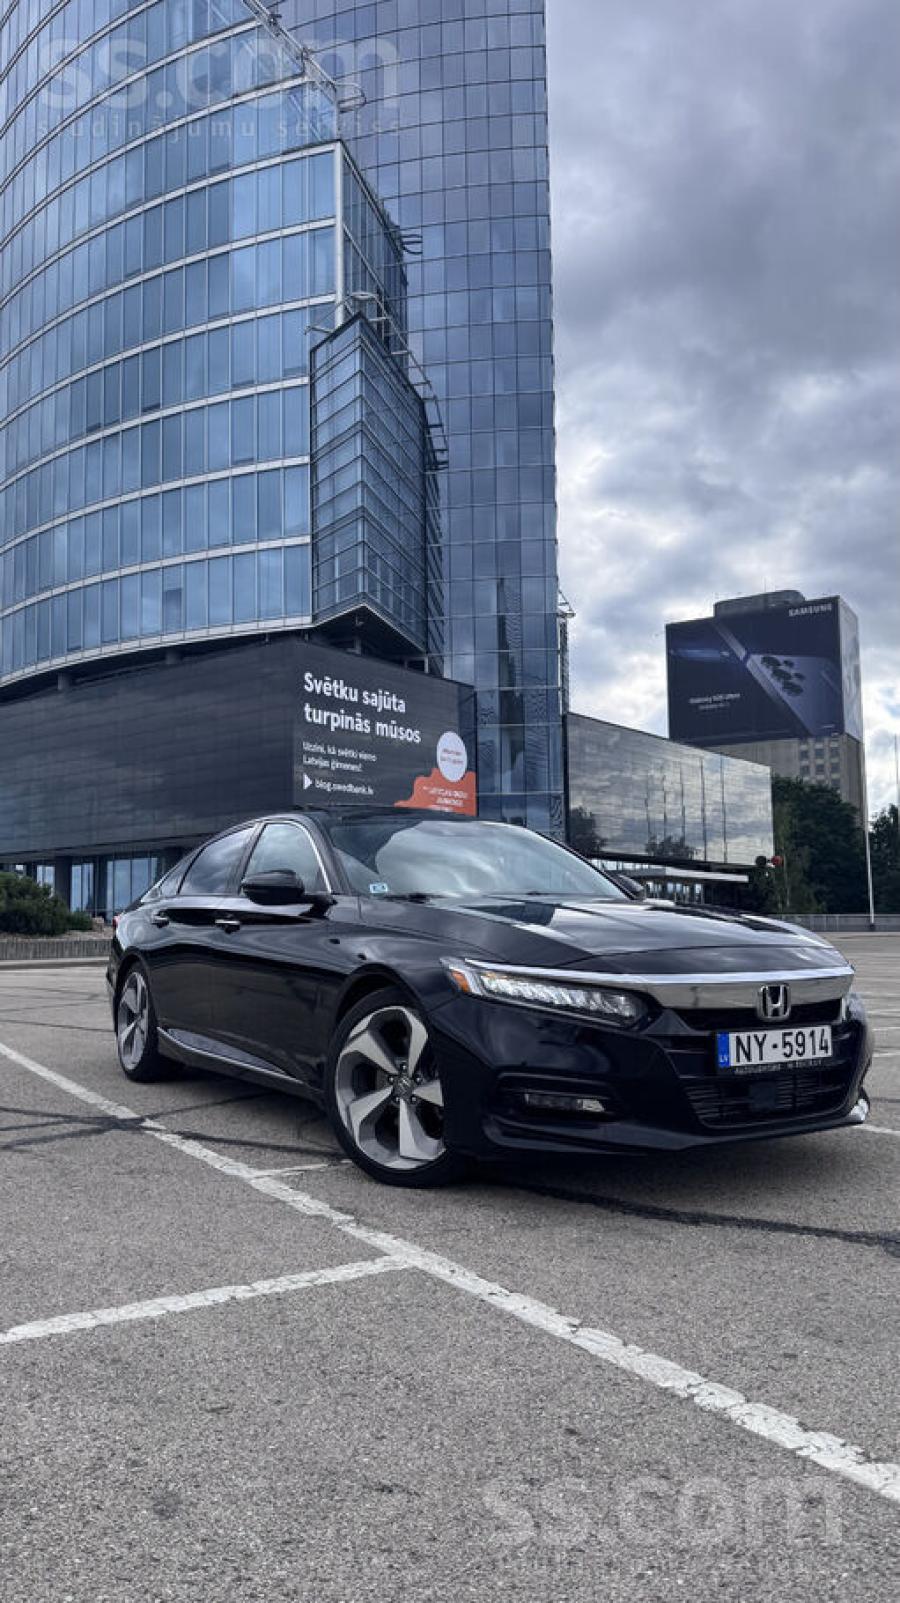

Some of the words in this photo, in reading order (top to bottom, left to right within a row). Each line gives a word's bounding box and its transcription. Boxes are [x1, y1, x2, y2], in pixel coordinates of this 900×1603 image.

[303, 671, 359, 702] Svētku
[362, 689, 406, 713] sajūta
[303, 703, 371, 734] turpinās
[375, 719, 422, 744] mūsos
[735, 1028, 829, 1063] NY-5914
